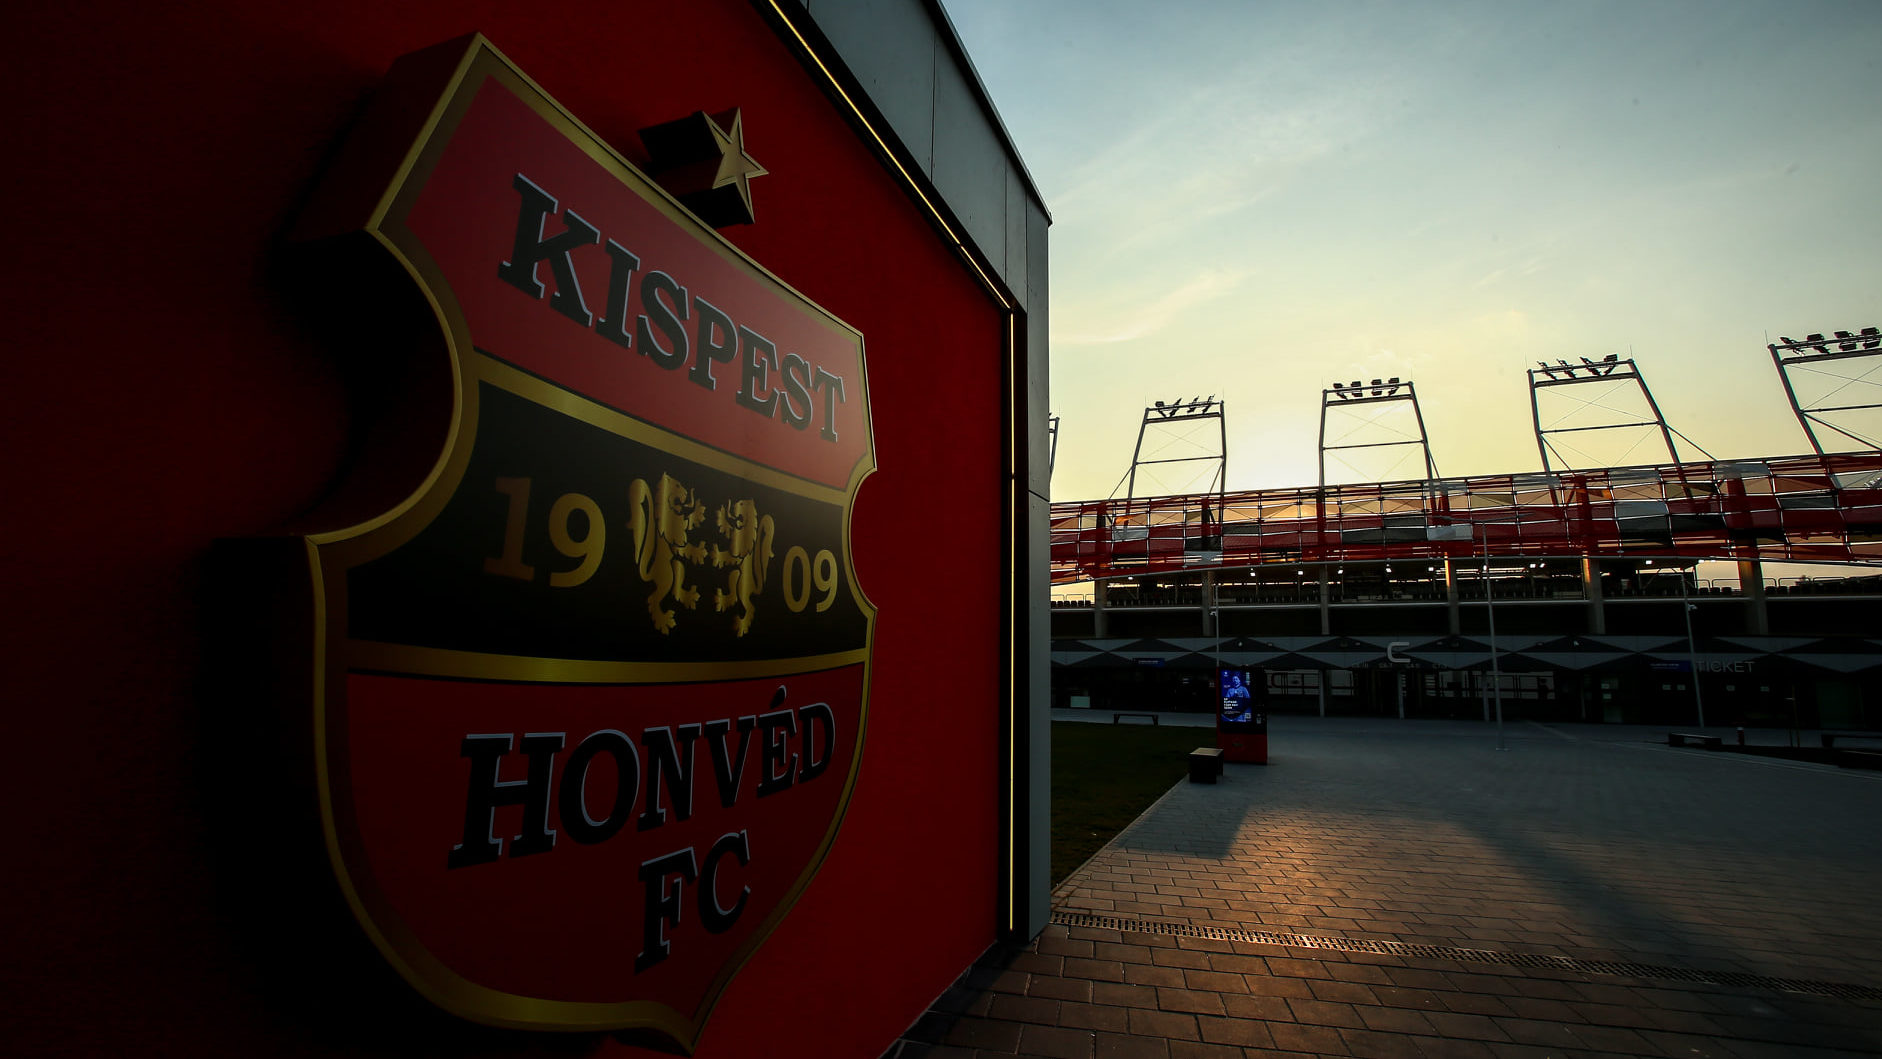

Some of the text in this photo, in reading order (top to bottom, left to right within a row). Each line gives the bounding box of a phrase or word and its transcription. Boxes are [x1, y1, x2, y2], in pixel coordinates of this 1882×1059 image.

[499, 172, 845, 442] KISPEST
[483, 476, 838, 613] 19 09
[1696, 661, 1755, 673] TICKET
[448, 686, 836, 868] HONVÉD
[634, 829, 751, 973] FC
